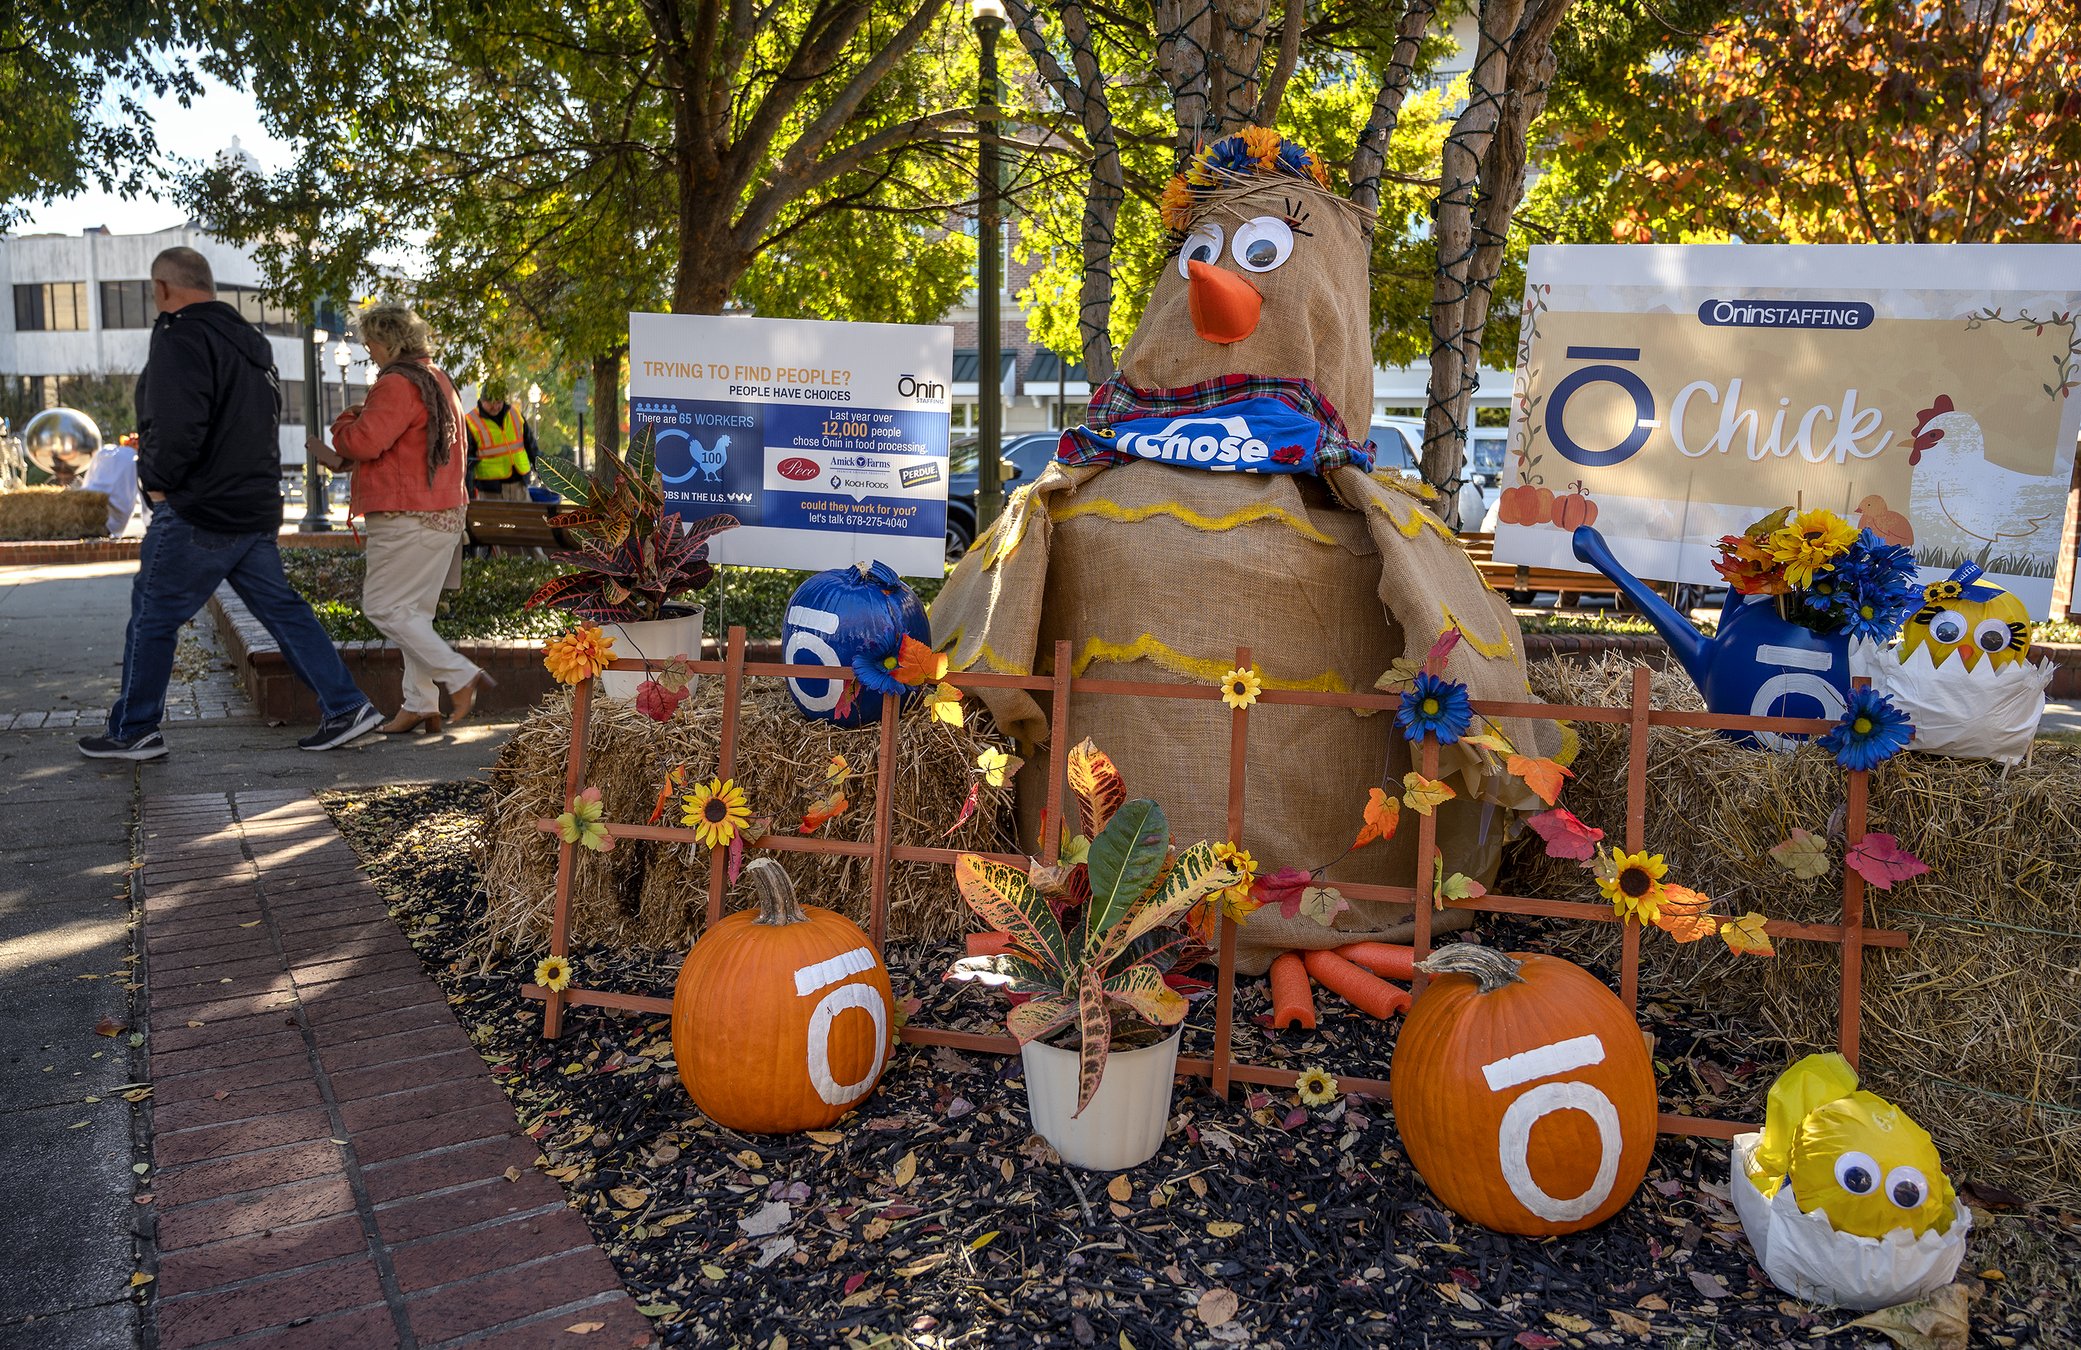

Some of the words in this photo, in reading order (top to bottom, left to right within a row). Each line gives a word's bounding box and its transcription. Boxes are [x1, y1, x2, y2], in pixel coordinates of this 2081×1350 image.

[643, 361, 703, 379] TRYING
[708, 364, 730, 380] TO
[735, 365, 771, 382] FIND
[776, 367, 851, 386] PEOPLE?
[729, 385, 770, 397] PEOPLE
[773, 387, 801, 399] HAVE
[804, 389, 851, 401] CHOICES
[897, 374, 944, 399] Ōnin
[636, 412, 661, 423] There
[663, 415, 677, 424] are
[679, 413, 692, 425] 65
[694, 413, 754, 428] WORKERS
[830, 410, 848, 420] Last
[851, 412, 871, 423] year
[873, 414, 893, 423] over
[821, 421, 868, 438] 12,000
[871, 427, 901, 438] people
[793, 436, 819, 446] chose
[845, 439, 853, 448] in
[855, 439, 875, 449] food
[701, 452, 722, 464] 100
[830, 456, 855, 466] Amick
[867, 458, 891, 468] Farms
[844, 479, 864, 487] KOCH
[866, 480, 889, 489] FOODS
[663, 490, 679, 500] OBS
[681, 491, 690, 500] IN
[691, 492, 708, 501] THE
[710, 493, 726, 502] U.S.
[801, 500, 827, 511] could
[829, 501, 850, 514] they
[851, 502, 875, 514] work
[877, 503, 891, 514] for
[893, 506, 917, 517] you?
[809, 512, 826, 523] let's
[828, 514, 844, 524] talk
[846, 514, 908, 528] 678-275-4040
